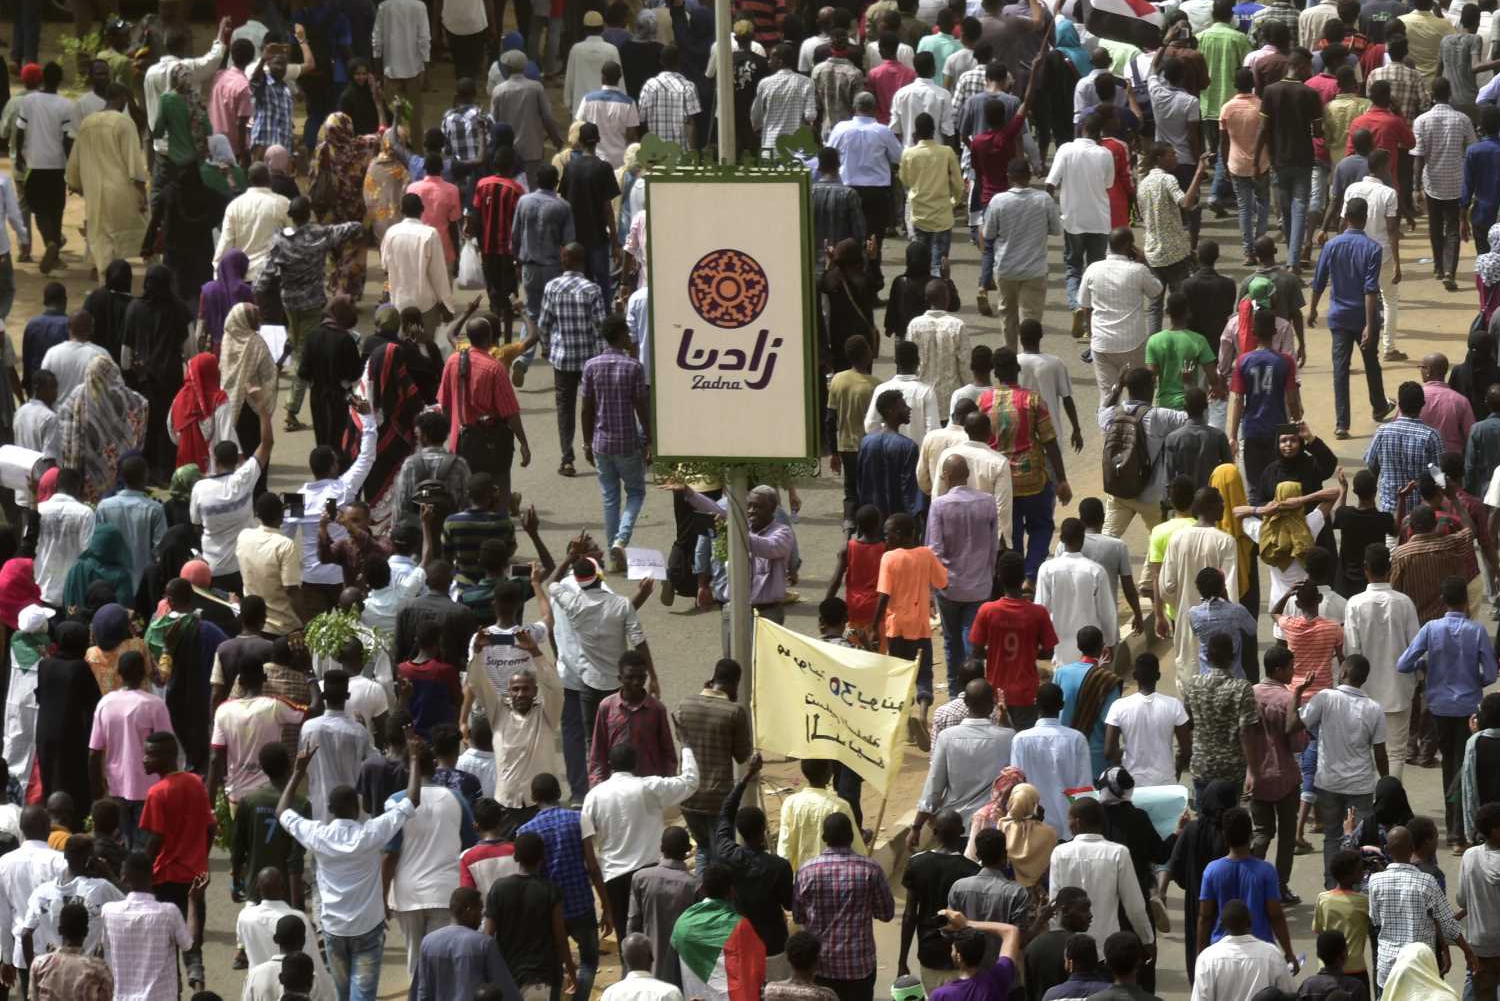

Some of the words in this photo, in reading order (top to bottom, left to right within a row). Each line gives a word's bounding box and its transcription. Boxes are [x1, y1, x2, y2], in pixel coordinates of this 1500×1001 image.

[677, 328, 784, 390] زادنا
[691, 374, 743, 390] Zadna
[1250, 365, 1273, 395] 14
[1004, 632, 1019, 661] 9
[264, 818, 277, 845] 7
